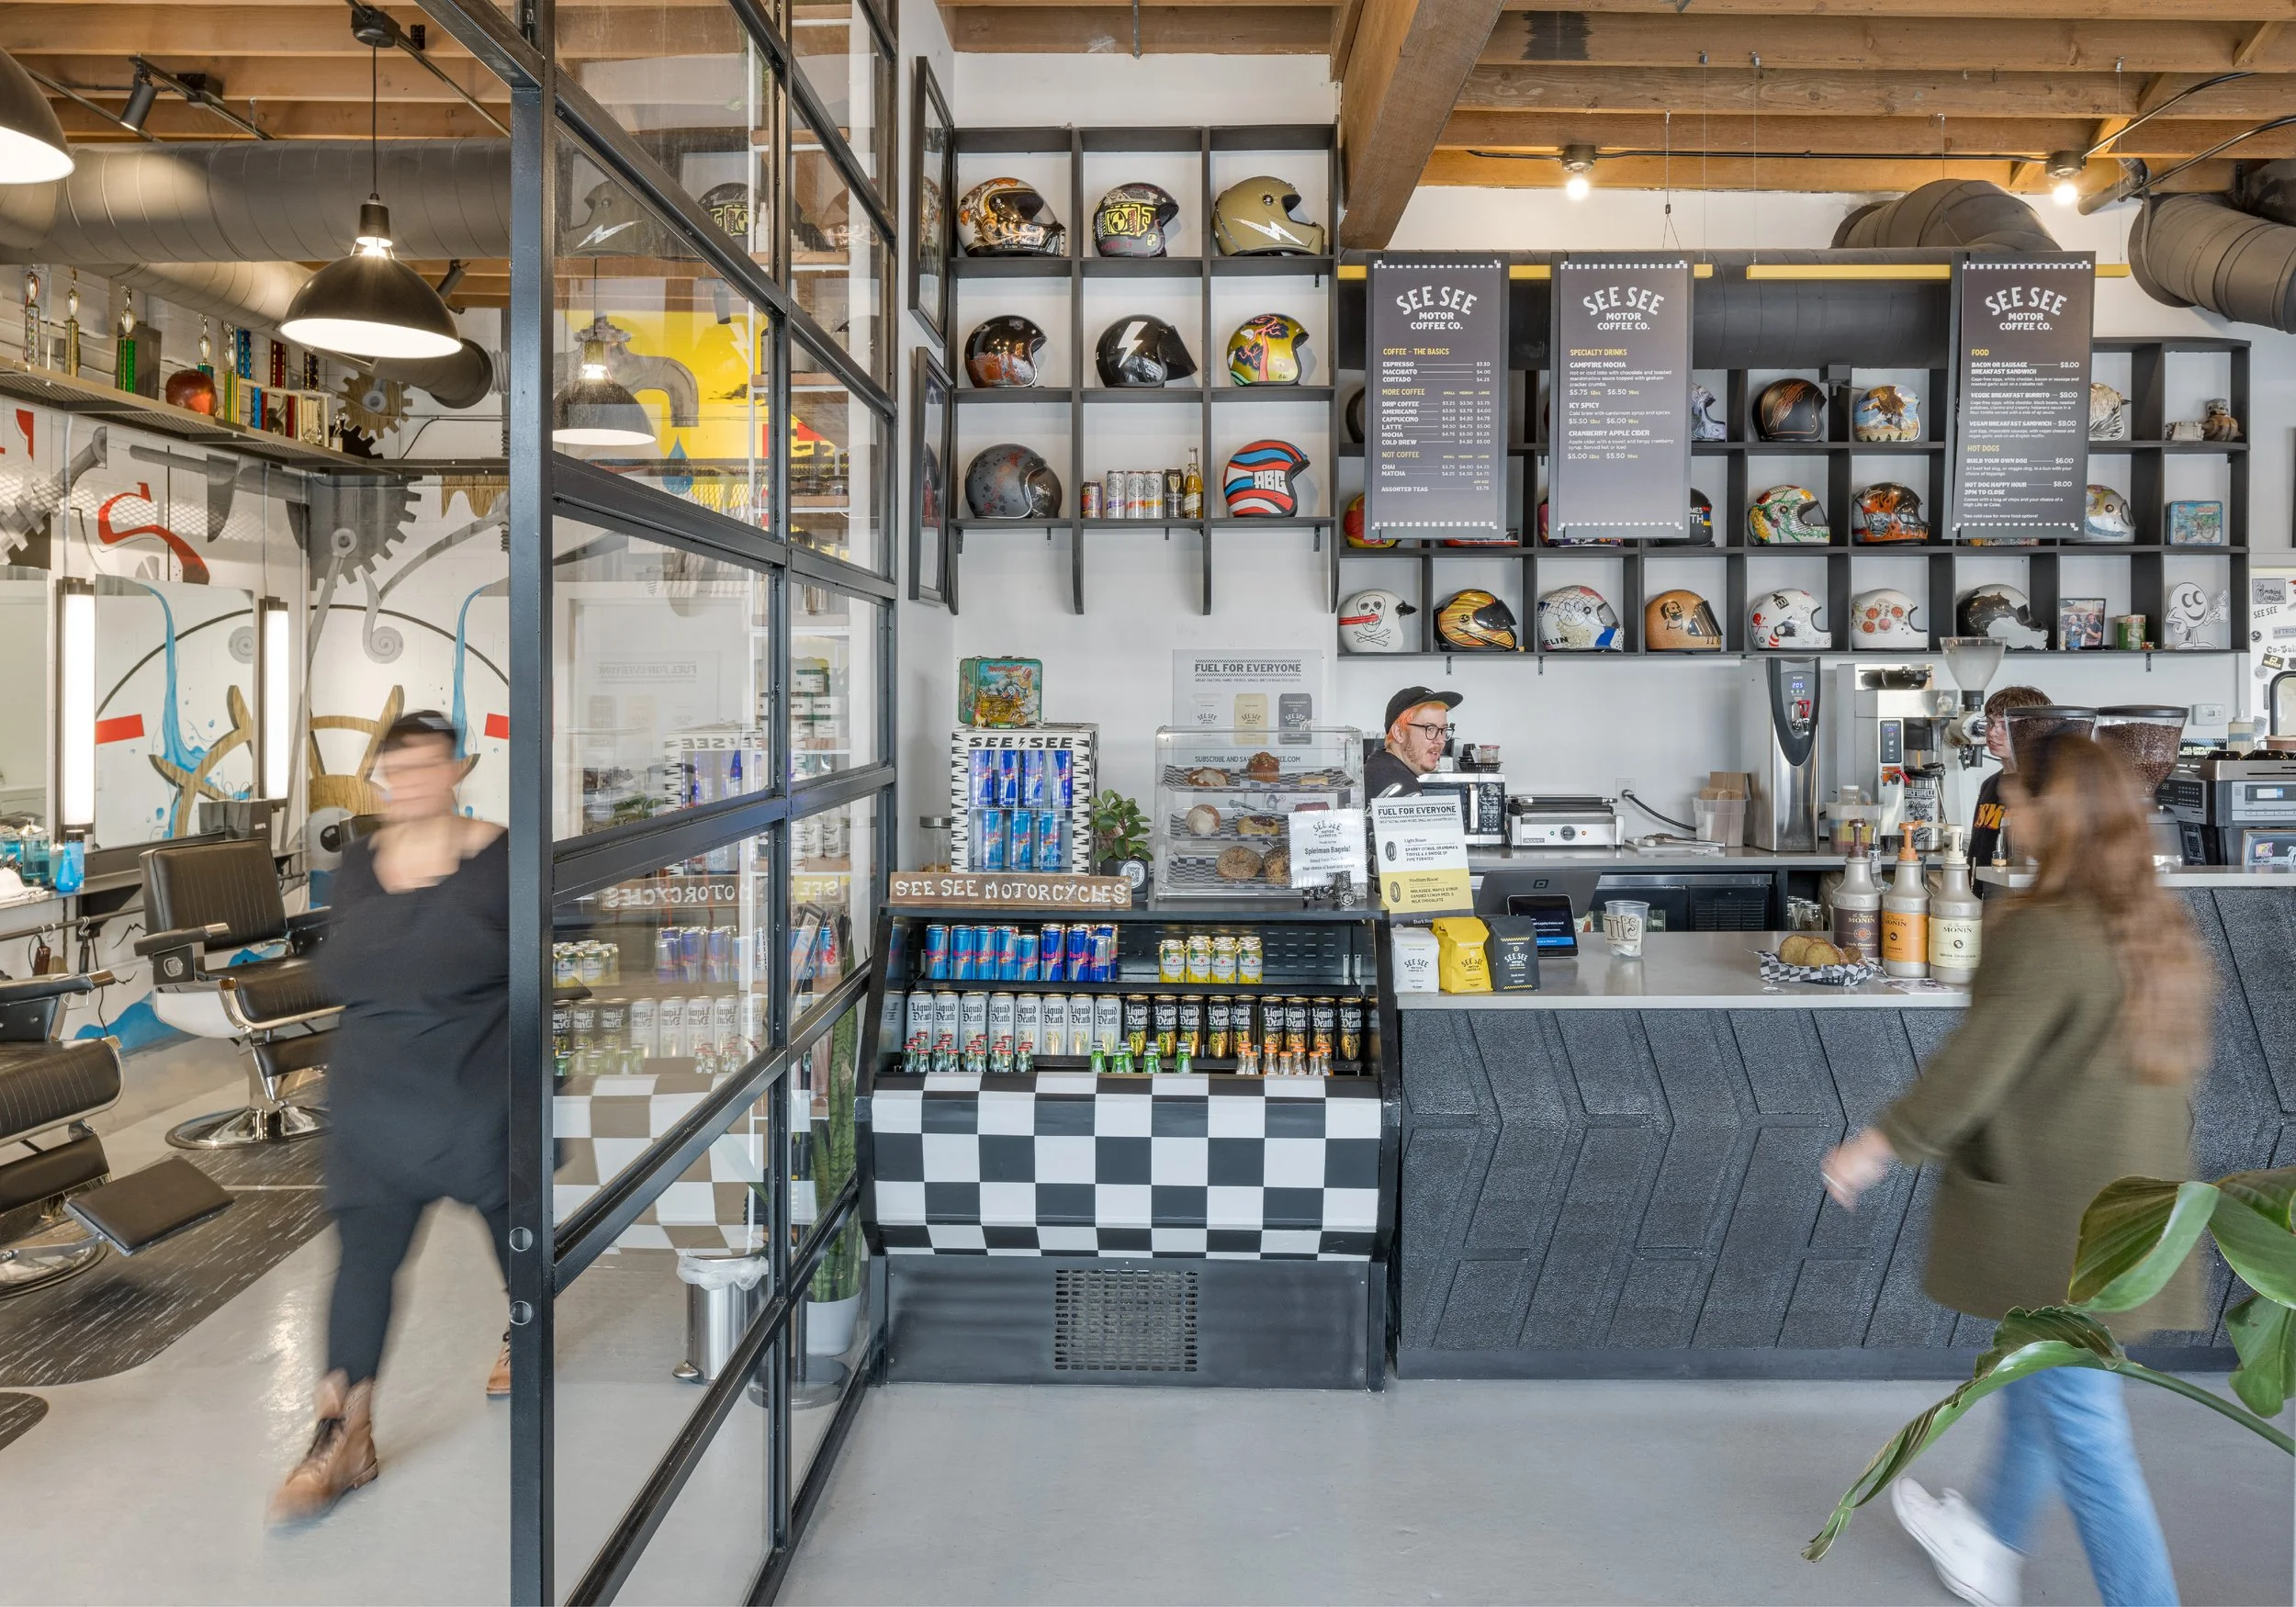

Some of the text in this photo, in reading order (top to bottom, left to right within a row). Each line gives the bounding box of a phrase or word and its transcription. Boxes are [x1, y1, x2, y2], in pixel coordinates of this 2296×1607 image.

[1396, 286, 1477, 315] SEE SEE
[1582, 287, 1664, 316] SEE SEE
[1986, 287, 2067, 316] SEE SEE
[1254, 470, 1289, 495] ABG
[1690, 514, 1703, 523] TH
[2254, 606, 2278, 619] SEE SEE
[1543, 637, 1569, 646] ELIN
[1195, 664, 1301, 672] FUEL FOR EVERYONE
[969, 737, 1073, 748] SEE SEE
[1313, 820, 1326, 832] SEE
[1305, 848, 1330, 856] Spielman
[895, 879, 1127, 905] SEE SEE MOTORCYCLES
[1604, 916, 1638, 938] TIPS
[1504, 953, 1527, 962] SEE SEE
[1404, 959, 1429, 968] SEE SEE
[1461, 959, 1473, 967] SEE
[990, 1004, 1010, 1013] Liquid
[1017, 1004, 1036, 1014] Liquid
[1043, 1005, 1064, 1014] Liquid
[1070, 1005, 1091, 1014] Liquid
[1097, 1006, 1117, 1015] Liquid
[1126, 1006, 1148, 1016] Liquid
[1208, 1006, 1229, 1016] Liquid
[990, 1013, 1010, 1022] Death
[1017, 1014, 1037, 1023] Death
[1340, 1009, 1361, 1019] Liquid
[1044, 1015, 1064, 1024] Death
[1071, 1015, 1091, 1024] Death
[1097, 1015, 1117, 1024] Death
[1127, 1016, 1148, 1026] Death
[1209, 1016, 1229, 1026] Death
[1341, 1019, 1361, 1028] Death
